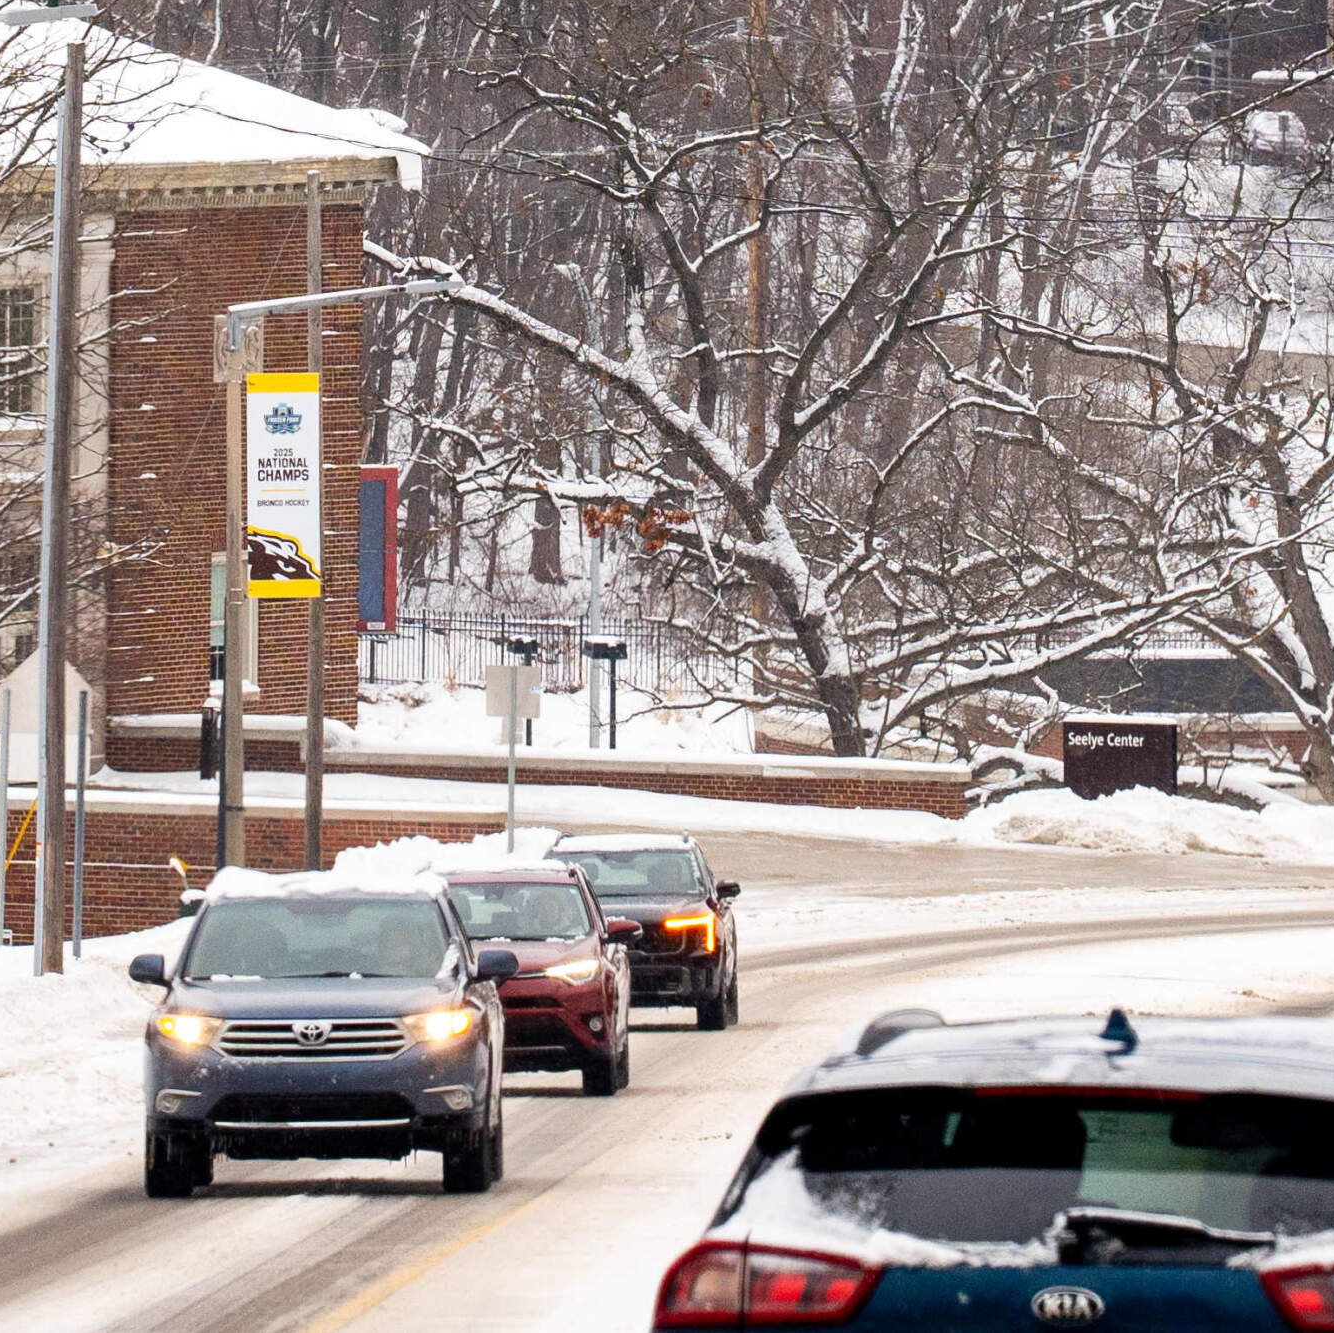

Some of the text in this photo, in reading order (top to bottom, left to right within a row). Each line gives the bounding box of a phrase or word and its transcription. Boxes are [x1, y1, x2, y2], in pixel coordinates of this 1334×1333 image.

[273, 448, 293, 456] 2025
[258, 458, 308, 468] NATIONAL
[258, 469, 309, 482] CHAMPS
[257, 499, 309, 507] BRONCO HOCKEY
[1068, 732, 1144, 750] Seelye Center
[1042, 1292, 1093, 1320] KIA
